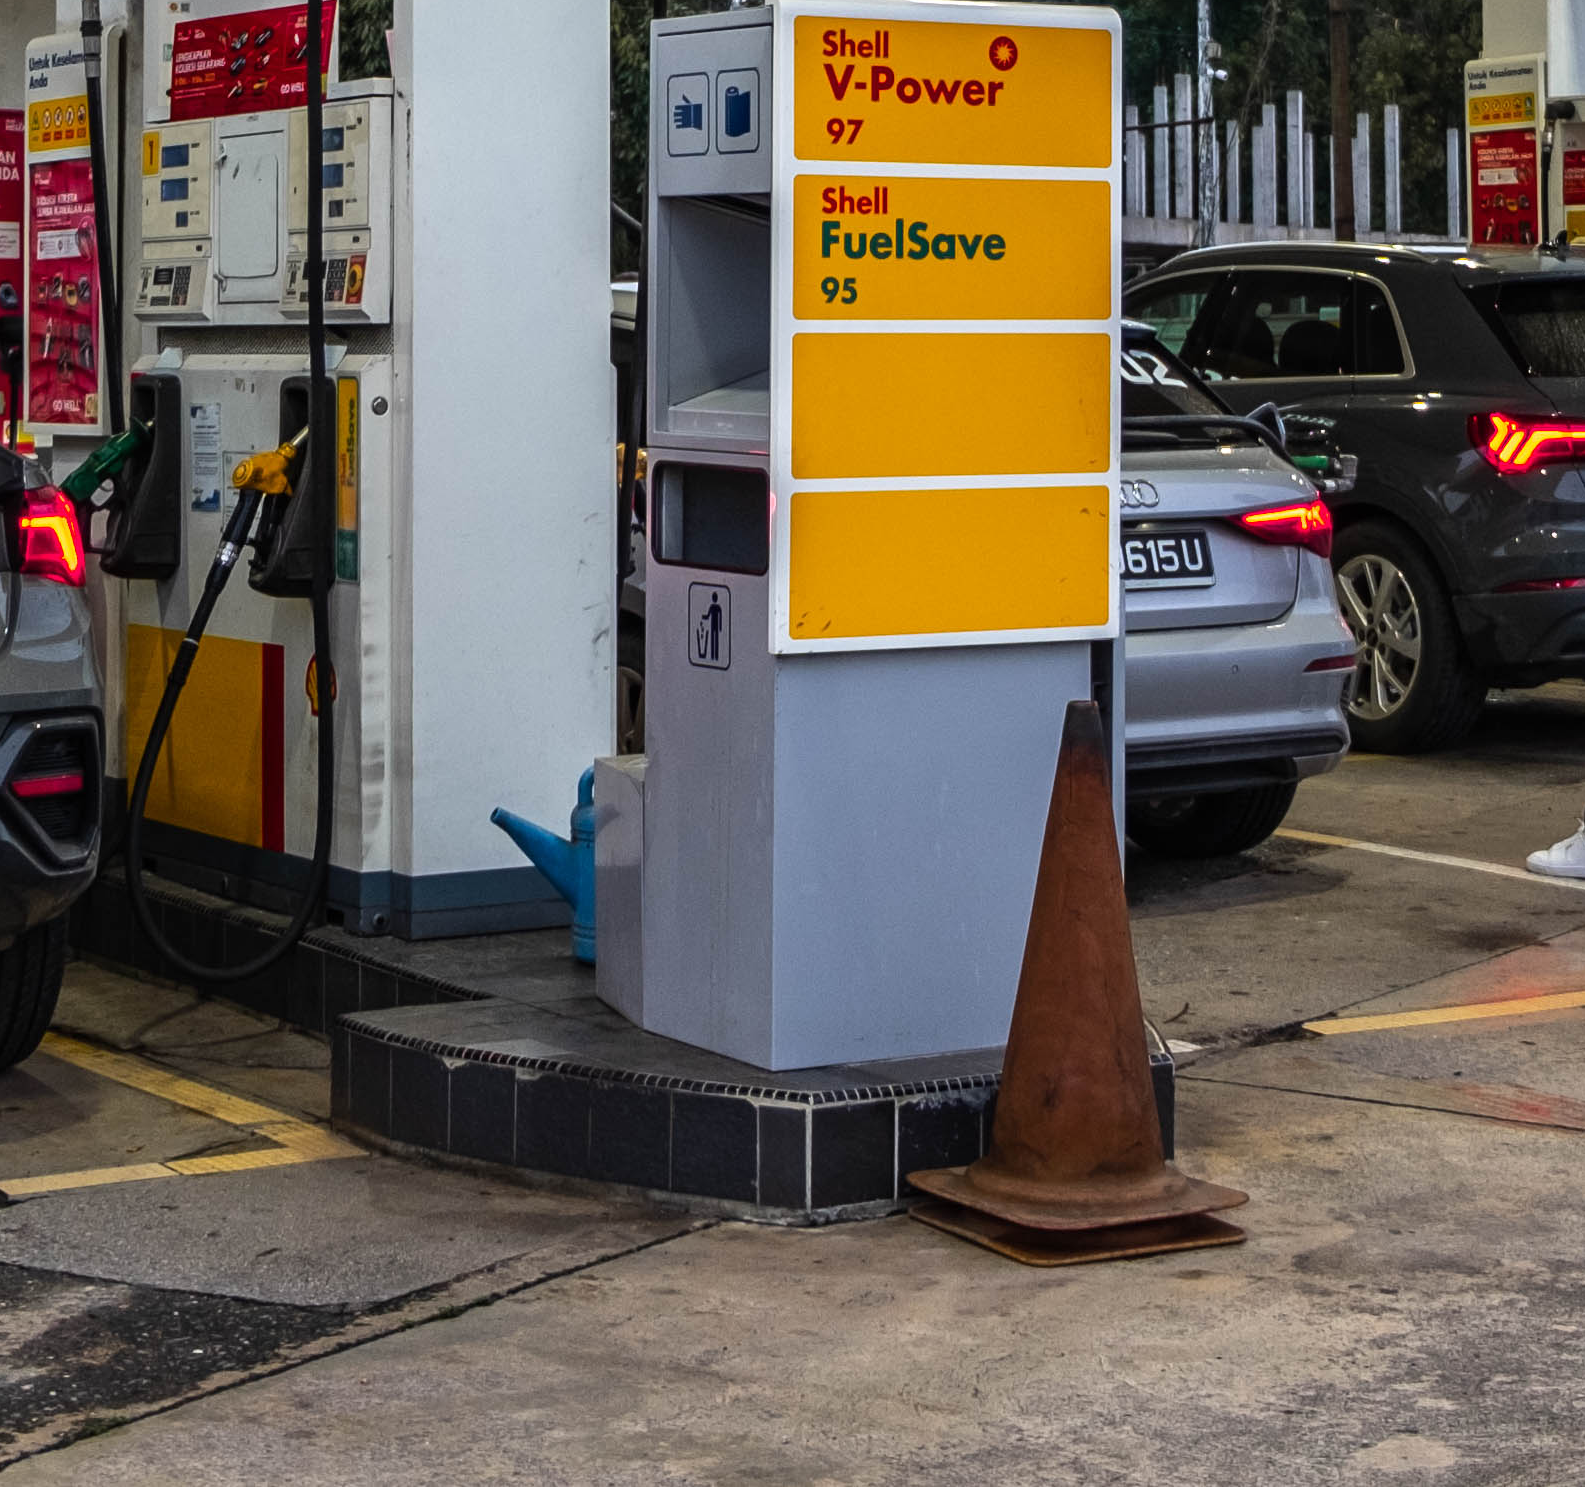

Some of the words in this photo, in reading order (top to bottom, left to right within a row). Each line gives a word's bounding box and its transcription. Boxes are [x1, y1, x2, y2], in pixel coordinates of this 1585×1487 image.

[822, 30, 890, 60] Shell
[29, 73, 48, 90] Anda
[823, 64, 1004, 107] V-Power
[826, 119, 863, 145] 97
[822, 187, 889, 215] Shell
[822, 220, 1006, 260] FuelSave
[821, 278, 857, 305] 95
[1120, 538, 1203, 574] 615U
